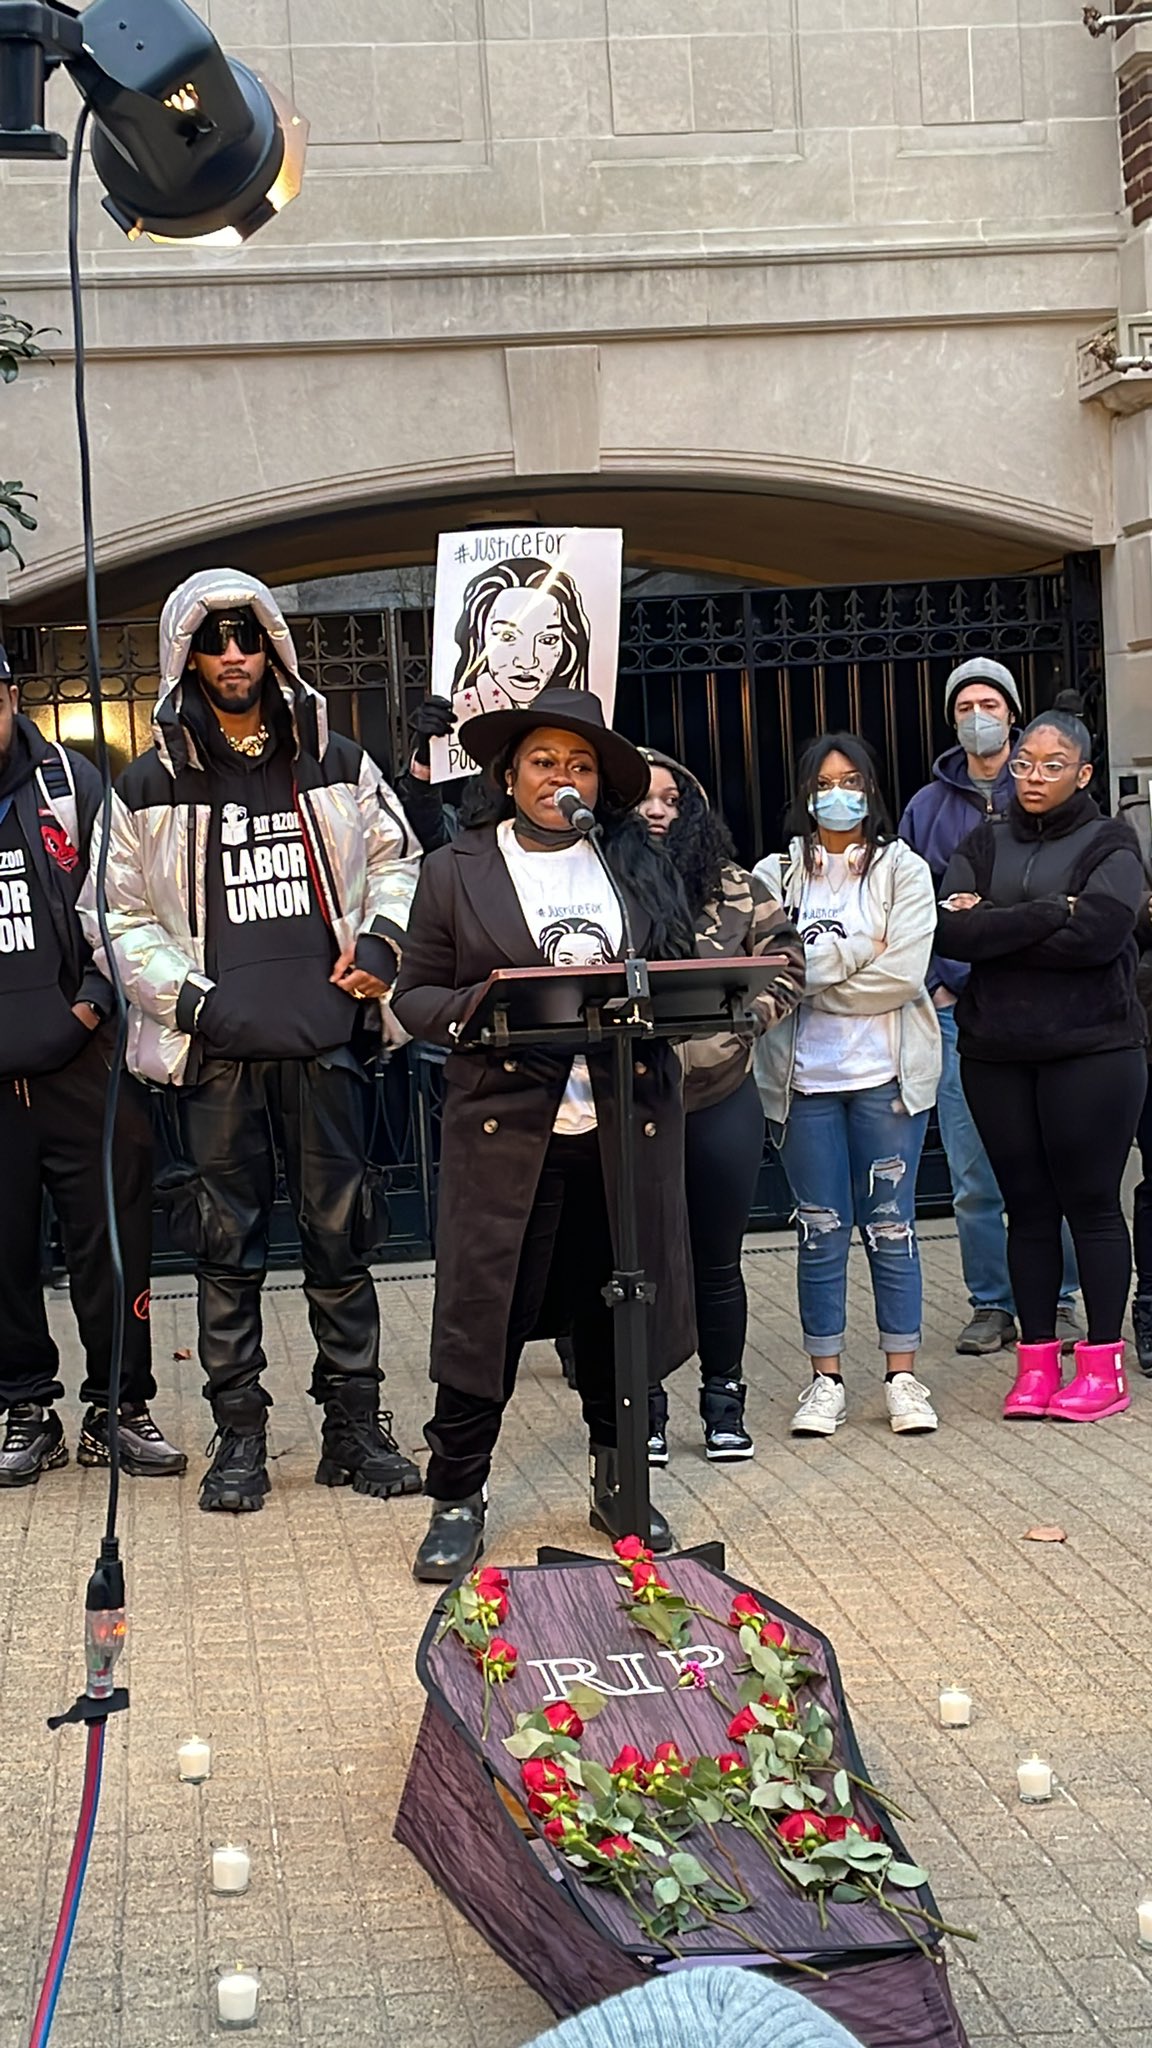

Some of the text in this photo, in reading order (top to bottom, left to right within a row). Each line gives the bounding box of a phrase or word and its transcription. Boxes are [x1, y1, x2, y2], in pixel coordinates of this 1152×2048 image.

[222, 842, 308, 887] LABOR
[226, 880, 311, 924] UNION
[527, 1645, 725, 1701] RIP
